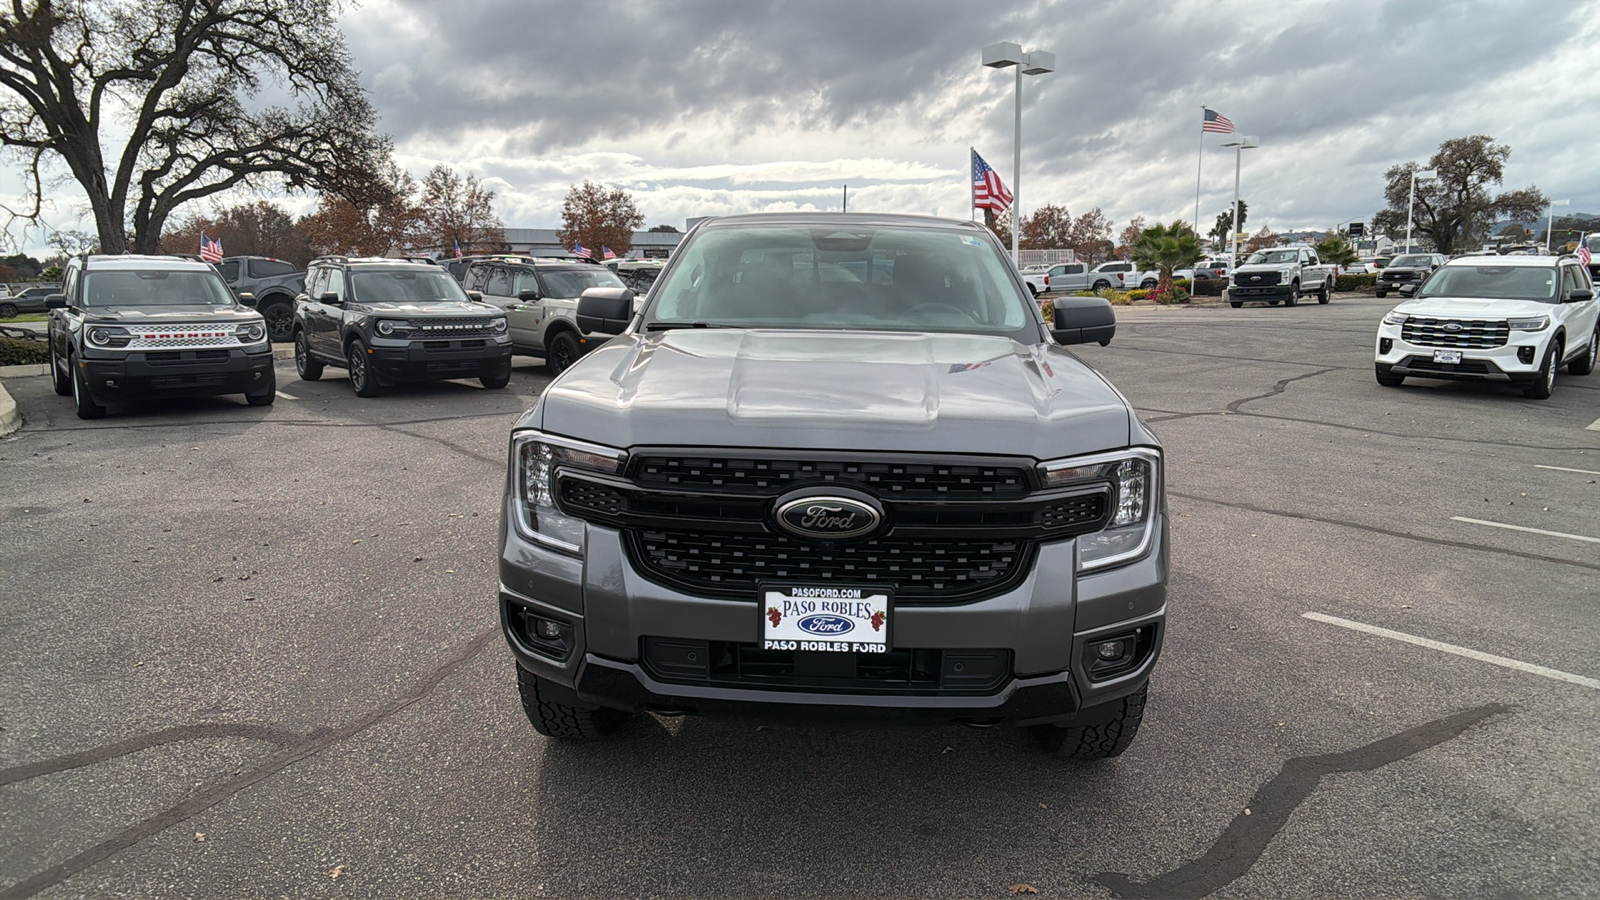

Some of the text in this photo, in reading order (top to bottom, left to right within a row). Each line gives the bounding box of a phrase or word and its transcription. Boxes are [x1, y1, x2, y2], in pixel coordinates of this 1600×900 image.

[801, 505, 856, 529] Ford
[792, 587, 861, 599] PASOFORD.COM
[782, 600, 872, 620] PASO ROBLES
[809, 617, 844, 632] Ford
[765, 640, 886, 653] PASO ROBLES FORD
